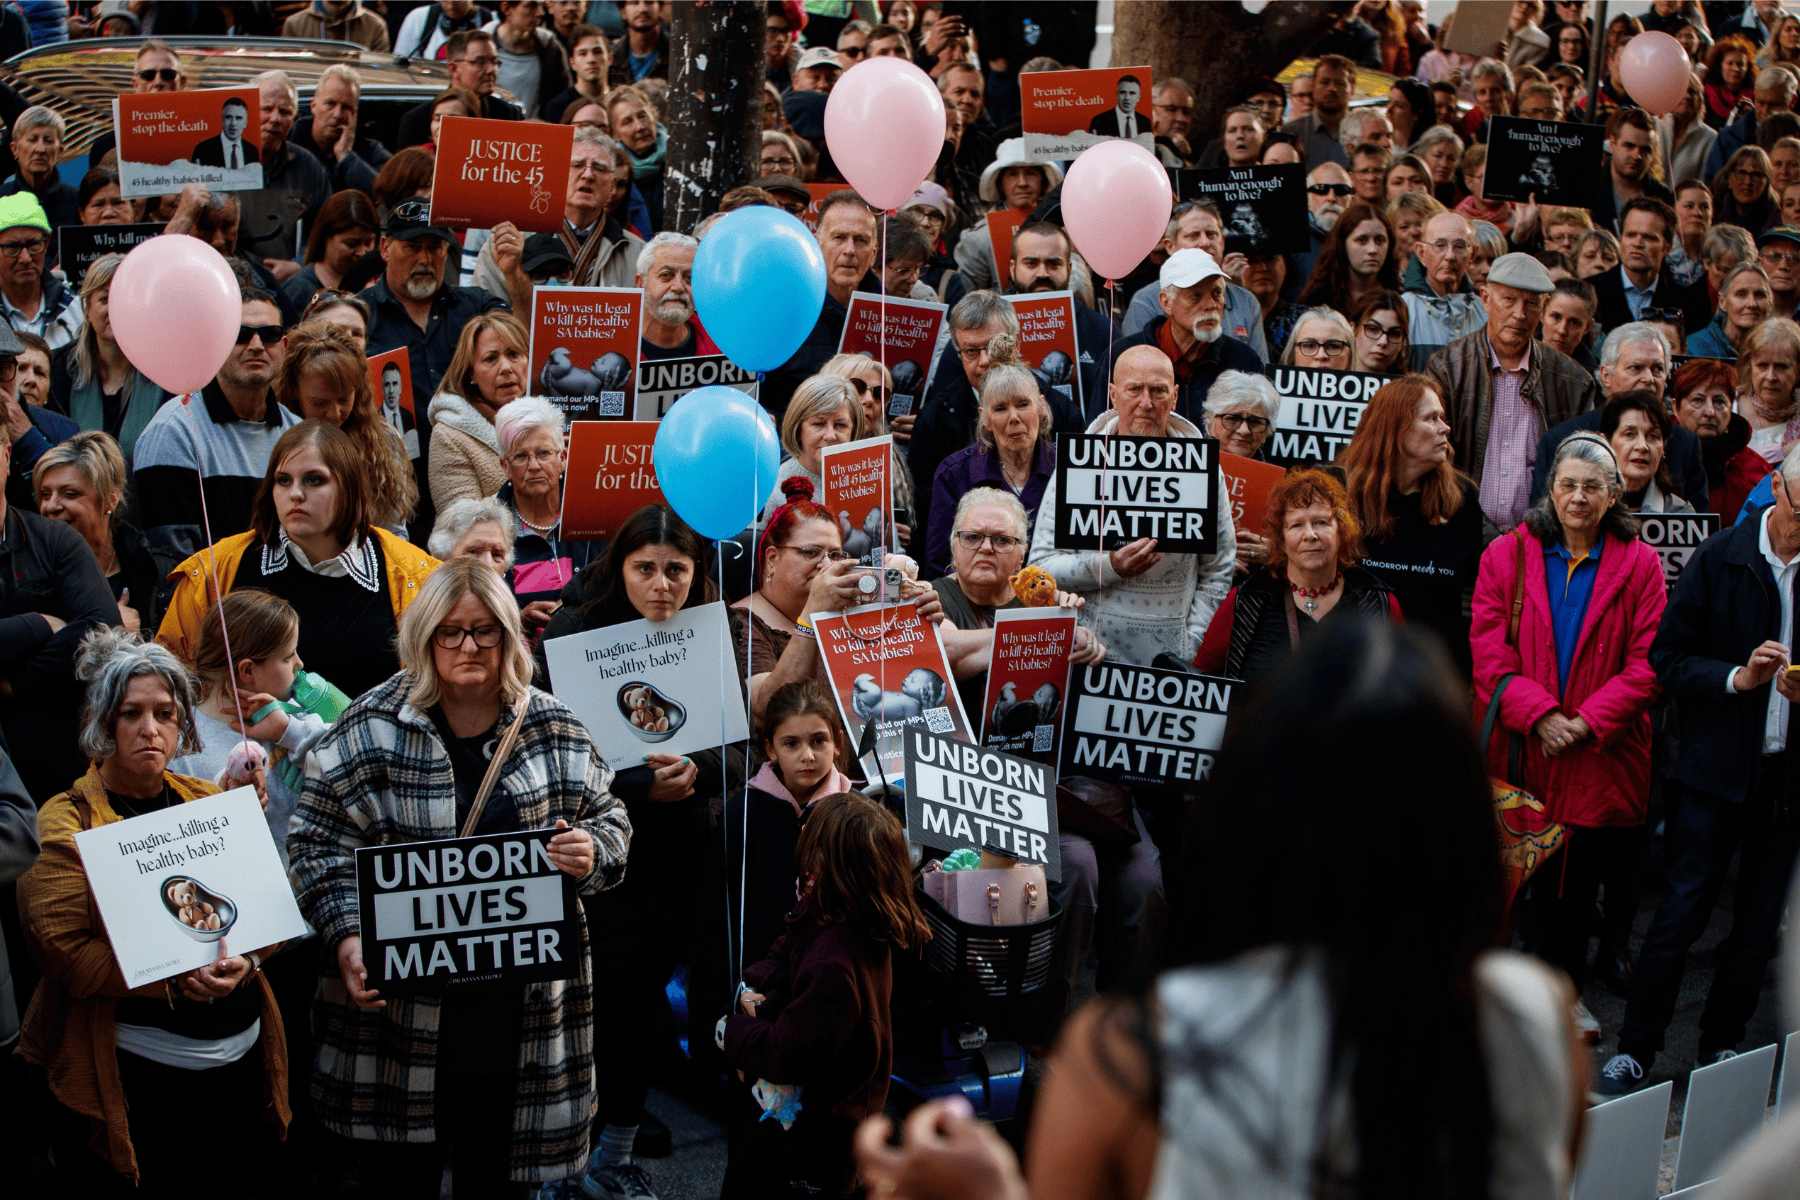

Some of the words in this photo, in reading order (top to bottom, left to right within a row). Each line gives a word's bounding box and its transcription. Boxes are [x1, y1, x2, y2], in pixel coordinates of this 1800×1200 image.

[1034, 100, 1056, 110] stop
[1058, 97, 1073, 108] the
[1076, 95, 1104, 106] death
[132, 124, 156, 136] stop
[158, 122, 175, 132] the
[178, 120, 208, 132] death
[1535, 122, 1552, 134] Am
[1554, 124, 1558, 134] I
[466, 140, 542, 162] JUSTICE
[1033, 147, 1042, 155] 45
[1042, 145, 1070, 154] healthy
[1528, 142, 1539, 151] to
[1540, 142, 1562, 154] live?
[132, 178, 140, 187] 45
[142, 176, 170, 186] healthy
[172, 175, 200, 184] babies
[201, 174, 222, 184] killed
[461, 160, 490, 181] for
[493, 162, 521, 184] the
[524, 166, 544, 186] 45
[1228, 170, 1248, 180] Am
[1248, 168, 1253, 179] I
[1225, 192, 1236, 201] to
[1238, 189, 1262, 200] live?
[94, 233, 116, 247] Why
[119, 232, 134, 244] kill
[546, 301, 570, 314] Why
[572, 304, 593, 313] was
[595, 302, 602, 313] it
[604, 302, 630, 317] legal
[1017, 312, 1034, 320] was
[1036, 310, 1042, 318] it
[1043, 306, 1064, 320] legal
[544, 316, 555, 325] to
[558, 314, 574, 326] kill
[576, 316, 588, 326] 45
[590, 315, 631, 328] healthy
[860, 310, 880, 322] Why
[901, 316, 907, 324] it
[910, 316, 932, 330] legal
[1022, 322, 1032, 331] 45
[1033, 318, 1066, 330] healthy
[557, 328, 572, 338] SA
[574, 327, 616, 338] babies?
[856, 322, 866, 330] to
[868, 322, 882, 332] kill
[884, 325, 894, 334] 45
[895, 326, 930, 340] healthy
[1022, 330, 1056, 342] babies?
[864, 334, 878, 344] SA
[880, 336, 916, 348] babies?
[1274, 369, 1391, 401] UNBOR
[1296, 402, 1358, 430] LIVE
[600, 444, 654, 468] JUSTI
[1069, 438, 1208, 470] UNBORN
[831, 464, 846, 476] Why
[848, 464, 860, 472] was
[862, 460, 866, 470] it
[595, 467, 626, 489] for
[630, 467, 660, 489] the
[830, 481, 838, 490] to
[839, 475, 849, 488] kill
[851, 475, 858, 485] 45
[840, 490, 849, 500] SA
[850, 484, 876, 498] babies?
[1094, 474, 1180, 504] LIVES
[1069, 508, 1204, 540] MATTER
[1362, 558, 1408, 570] TOMORROW
[1411, 560, 1434, 575] needs
[1438, 568, 1454, 576] YOU
[686, 628, 694, 638] a
[859, 625, 882, 636] was
[893, 616, 922, 632] legal
[833, 644, 846, 654] to
[848, 639, 866, 652] kill
[883, 629, 926, 646] healthy
[1002, 632, 1020, 646] Why
[1022, 633, 1036, 642] was
[1038, 632, 1044, 642] it
[1045, 629, 1065, 644] legal
[852, 653, 870, 665] SA
[872, 644, 914, 662] babies?
[1000, 649, 1008, 658] to
[1010, 645, 1021, 658] kill
[1022, 646, 1032, 657] 45
[1033, 644, 1064, 656] healthy
[599, 658, 648, 680] healthy
[649, 648, 687, 668] baby?
[1008, 660, 1019, 671] SA
[1020, 658, 1052, 670] babies?
[1084, 665, 1232, 712] UNBORN
[907, 716, 924, 724] MPs
[1105, 704, 1198, 742] LIVES
[1022, 731, 1034, 739] MPs
[1011, 741, 1025, 749] now!
[916, 732, 1045, 796] UNBORN
[1074, 736, 1215, 781] MATTER
[942, 774, 1022, 821] LIVES
[221, 816, 229, 826] a
[922, 803, 1048, 864] MATTER
[136, 850, 186, 875] healthy
[187, 837, 224, 860] baby?
[374, 838, 560, 889] UNBORN
[412, 886, 528, 932] LIVES
[384, 928, 562, 980] MATTER
